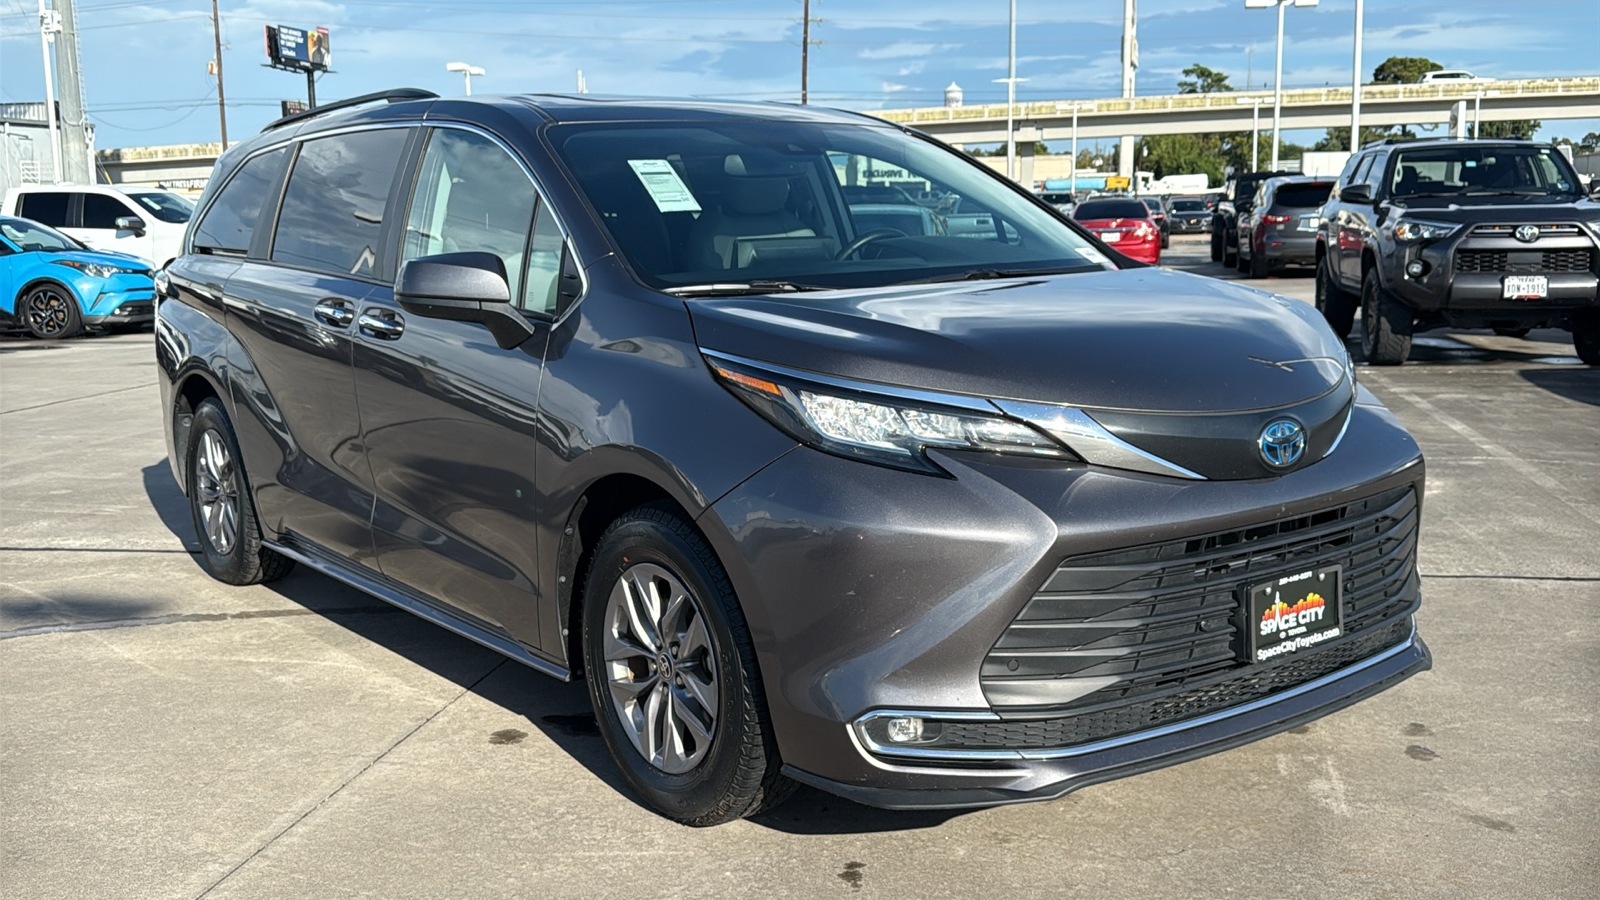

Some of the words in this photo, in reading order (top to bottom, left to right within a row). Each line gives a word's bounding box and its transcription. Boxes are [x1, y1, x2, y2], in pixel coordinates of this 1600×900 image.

[862, 169, 903, 178] EXCLUSIVE
[1260, 610, 1298, 636] SPACE
[1298, 605, 1325, 625] CITY
[1287, 626, 1307, 636] TOYOTA
[1257, 627, 1340, 661] SpaceCityToyota.com
